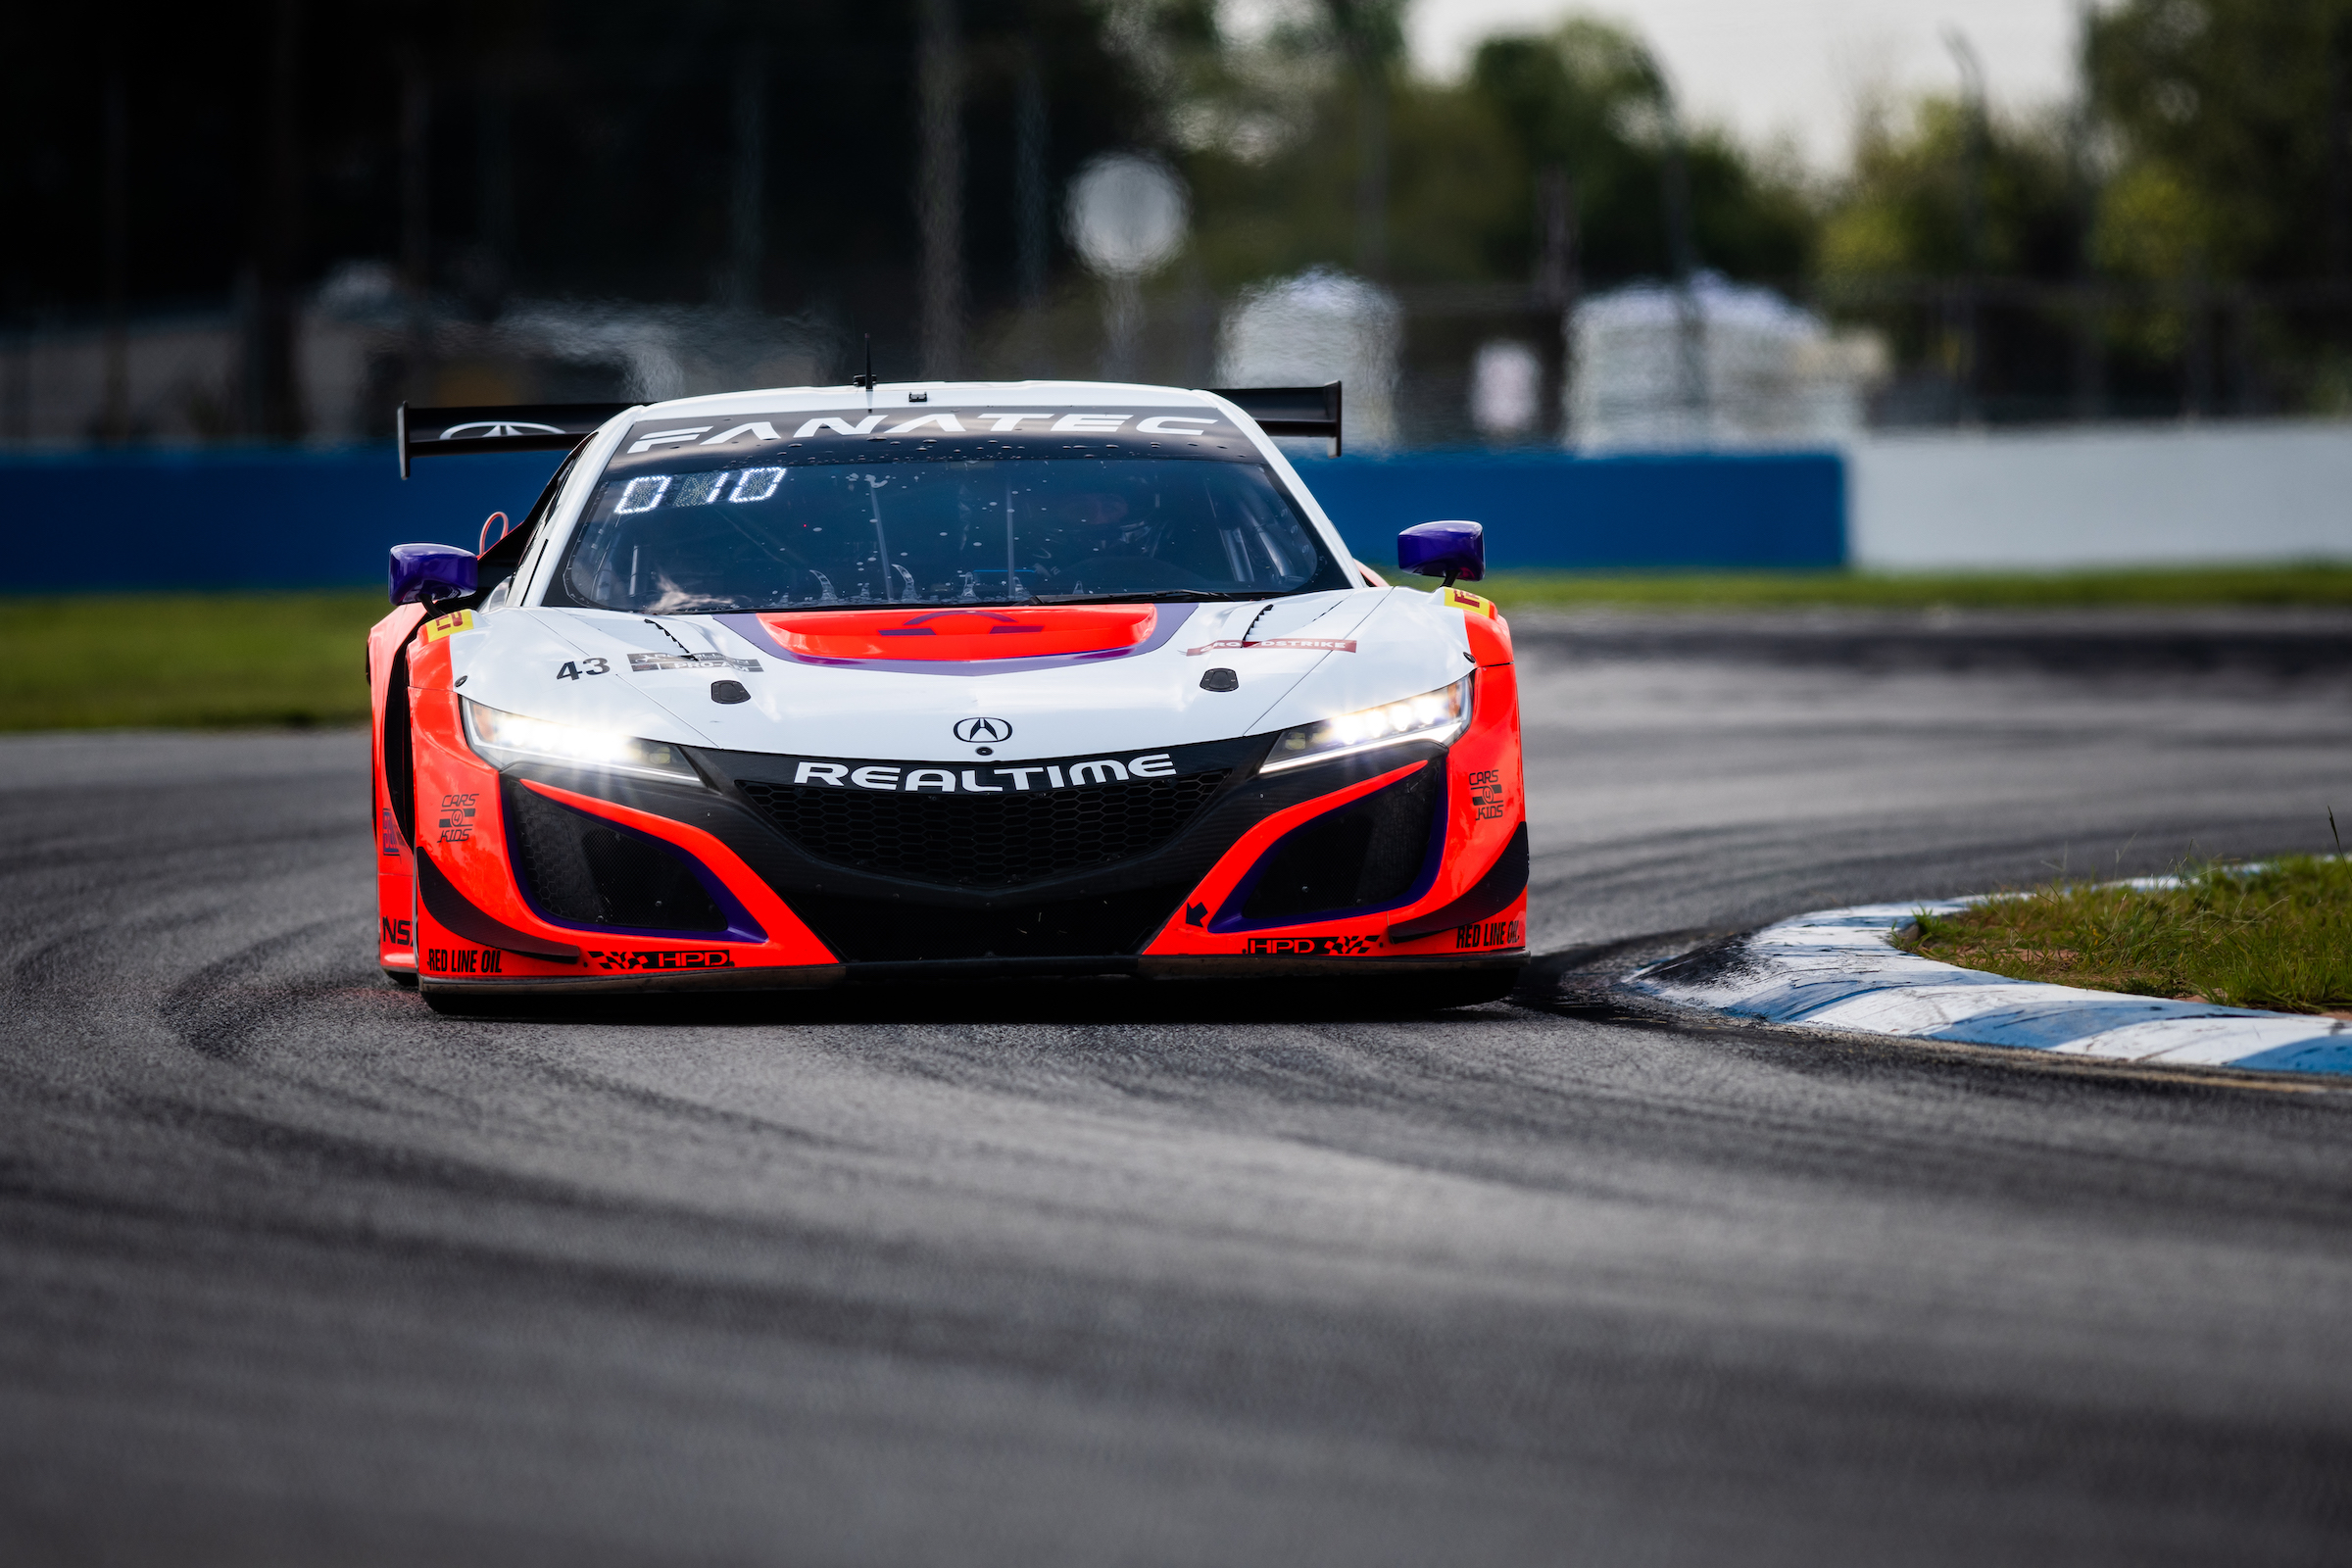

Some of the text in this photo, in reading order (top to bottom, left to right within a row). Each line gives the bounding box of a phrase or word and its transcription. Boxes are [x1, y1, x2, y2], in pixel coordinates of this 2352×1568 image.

[625, 413, 1219, 454] FANATEC
[614, 466, 787, 514] 010
[556, 657, 611, 681] 43
[793, 753, 1177, 793] REALTIME
[1468, 769, 1499, 785] CARS
[441, 793, 480, 808] CARS
[1475, 804, 1504, 821] KIDS
[436, 828, 472, 844] KIDS
[382, 915, 414, 948] NS
[1455, 923, 1481, 949] RED
[1483, 921, 1506, 947] LINE
[658, 951, 729, 967] HPD
[1250, 939, 1315, 955] HPD
[428, 948, 503, 973] RED LINE OIL
